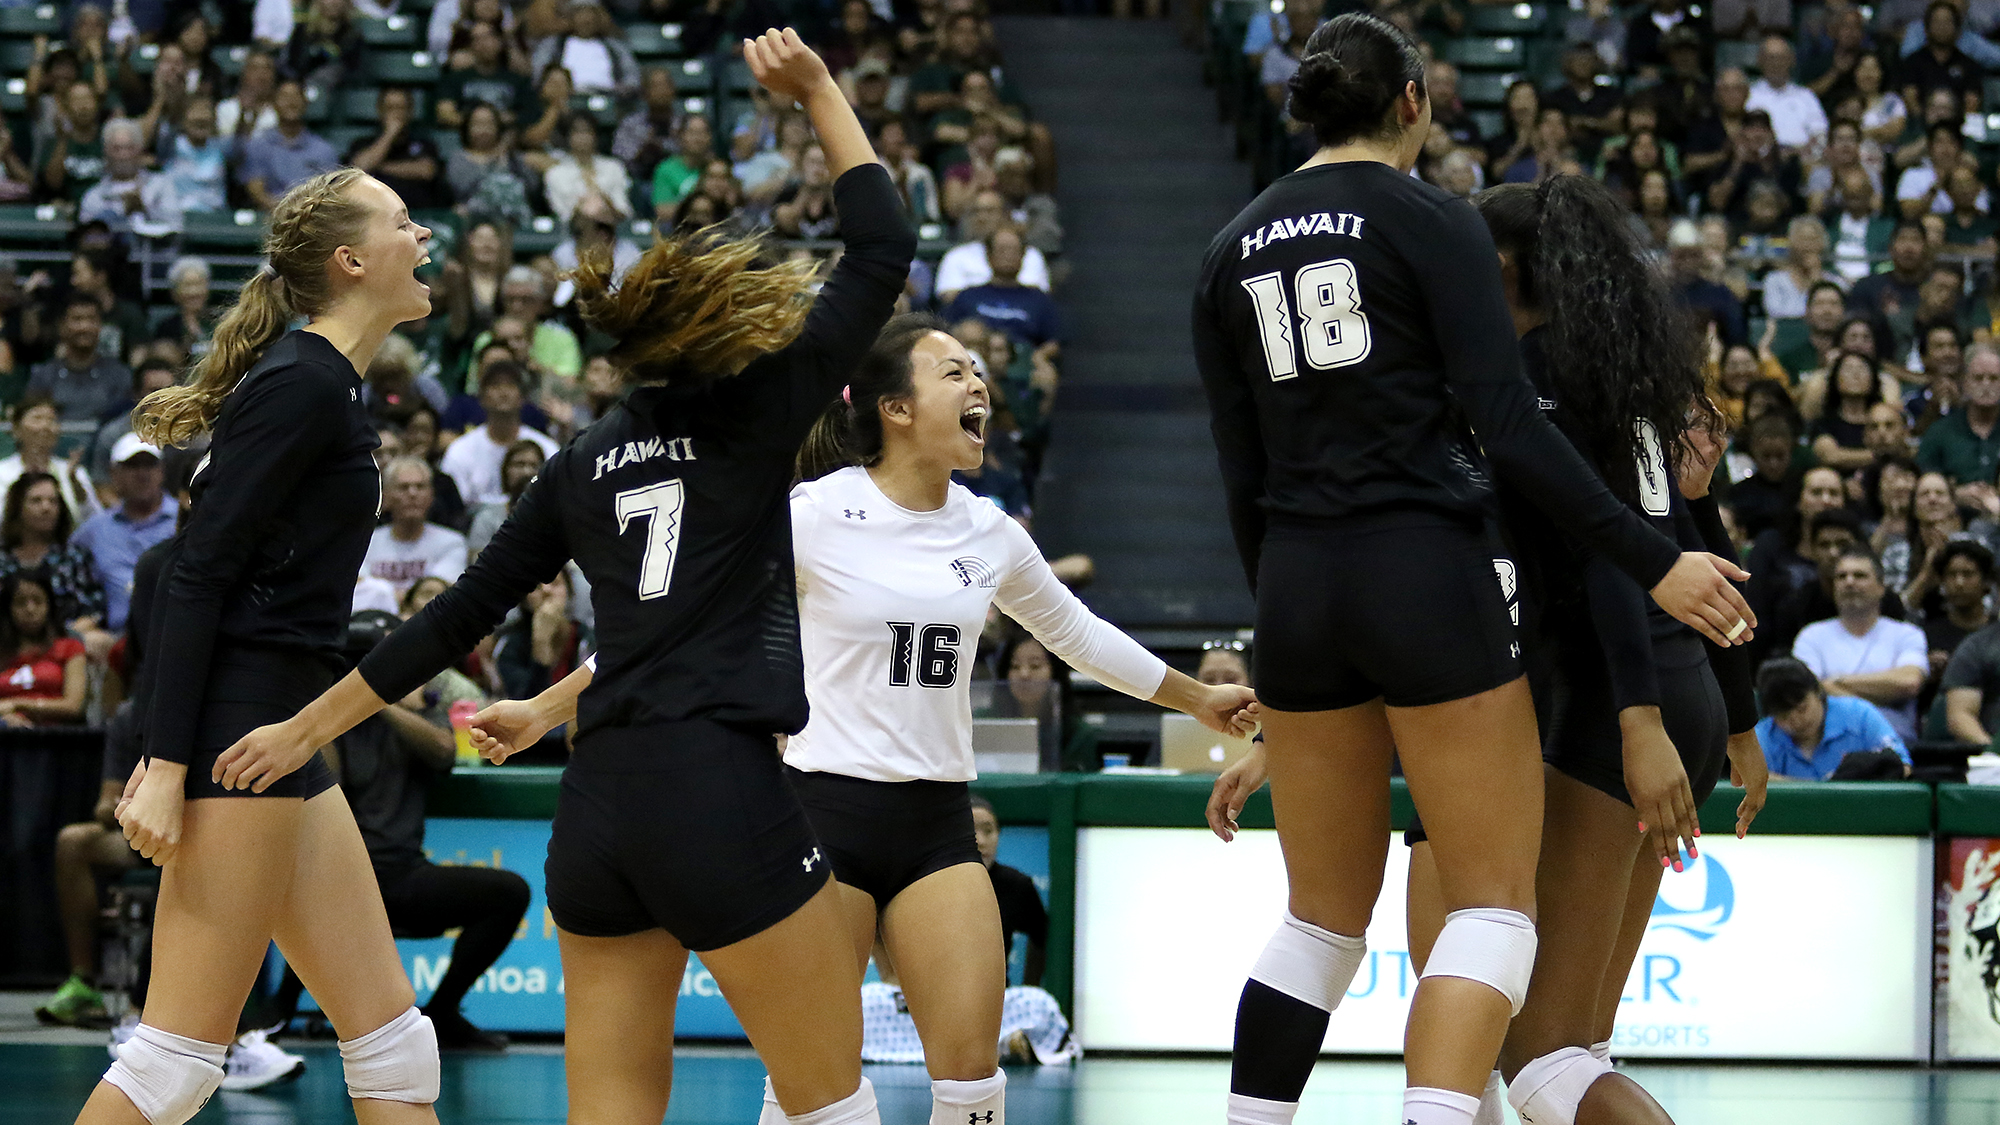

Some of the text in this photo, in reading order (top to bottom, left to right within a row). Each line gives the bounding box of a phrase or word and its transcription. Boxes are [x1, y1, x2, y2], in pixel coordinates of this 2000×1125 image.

[1240, 258, 1372, 382] 18
[615, 477, 685, 601] 7
[9, 664, 35, 690] 4
[886, 621, 961, 689] 16
[413, 954, 547, 994] Mnoa
[1613, 1024, 1710, 1047] ESORTS
